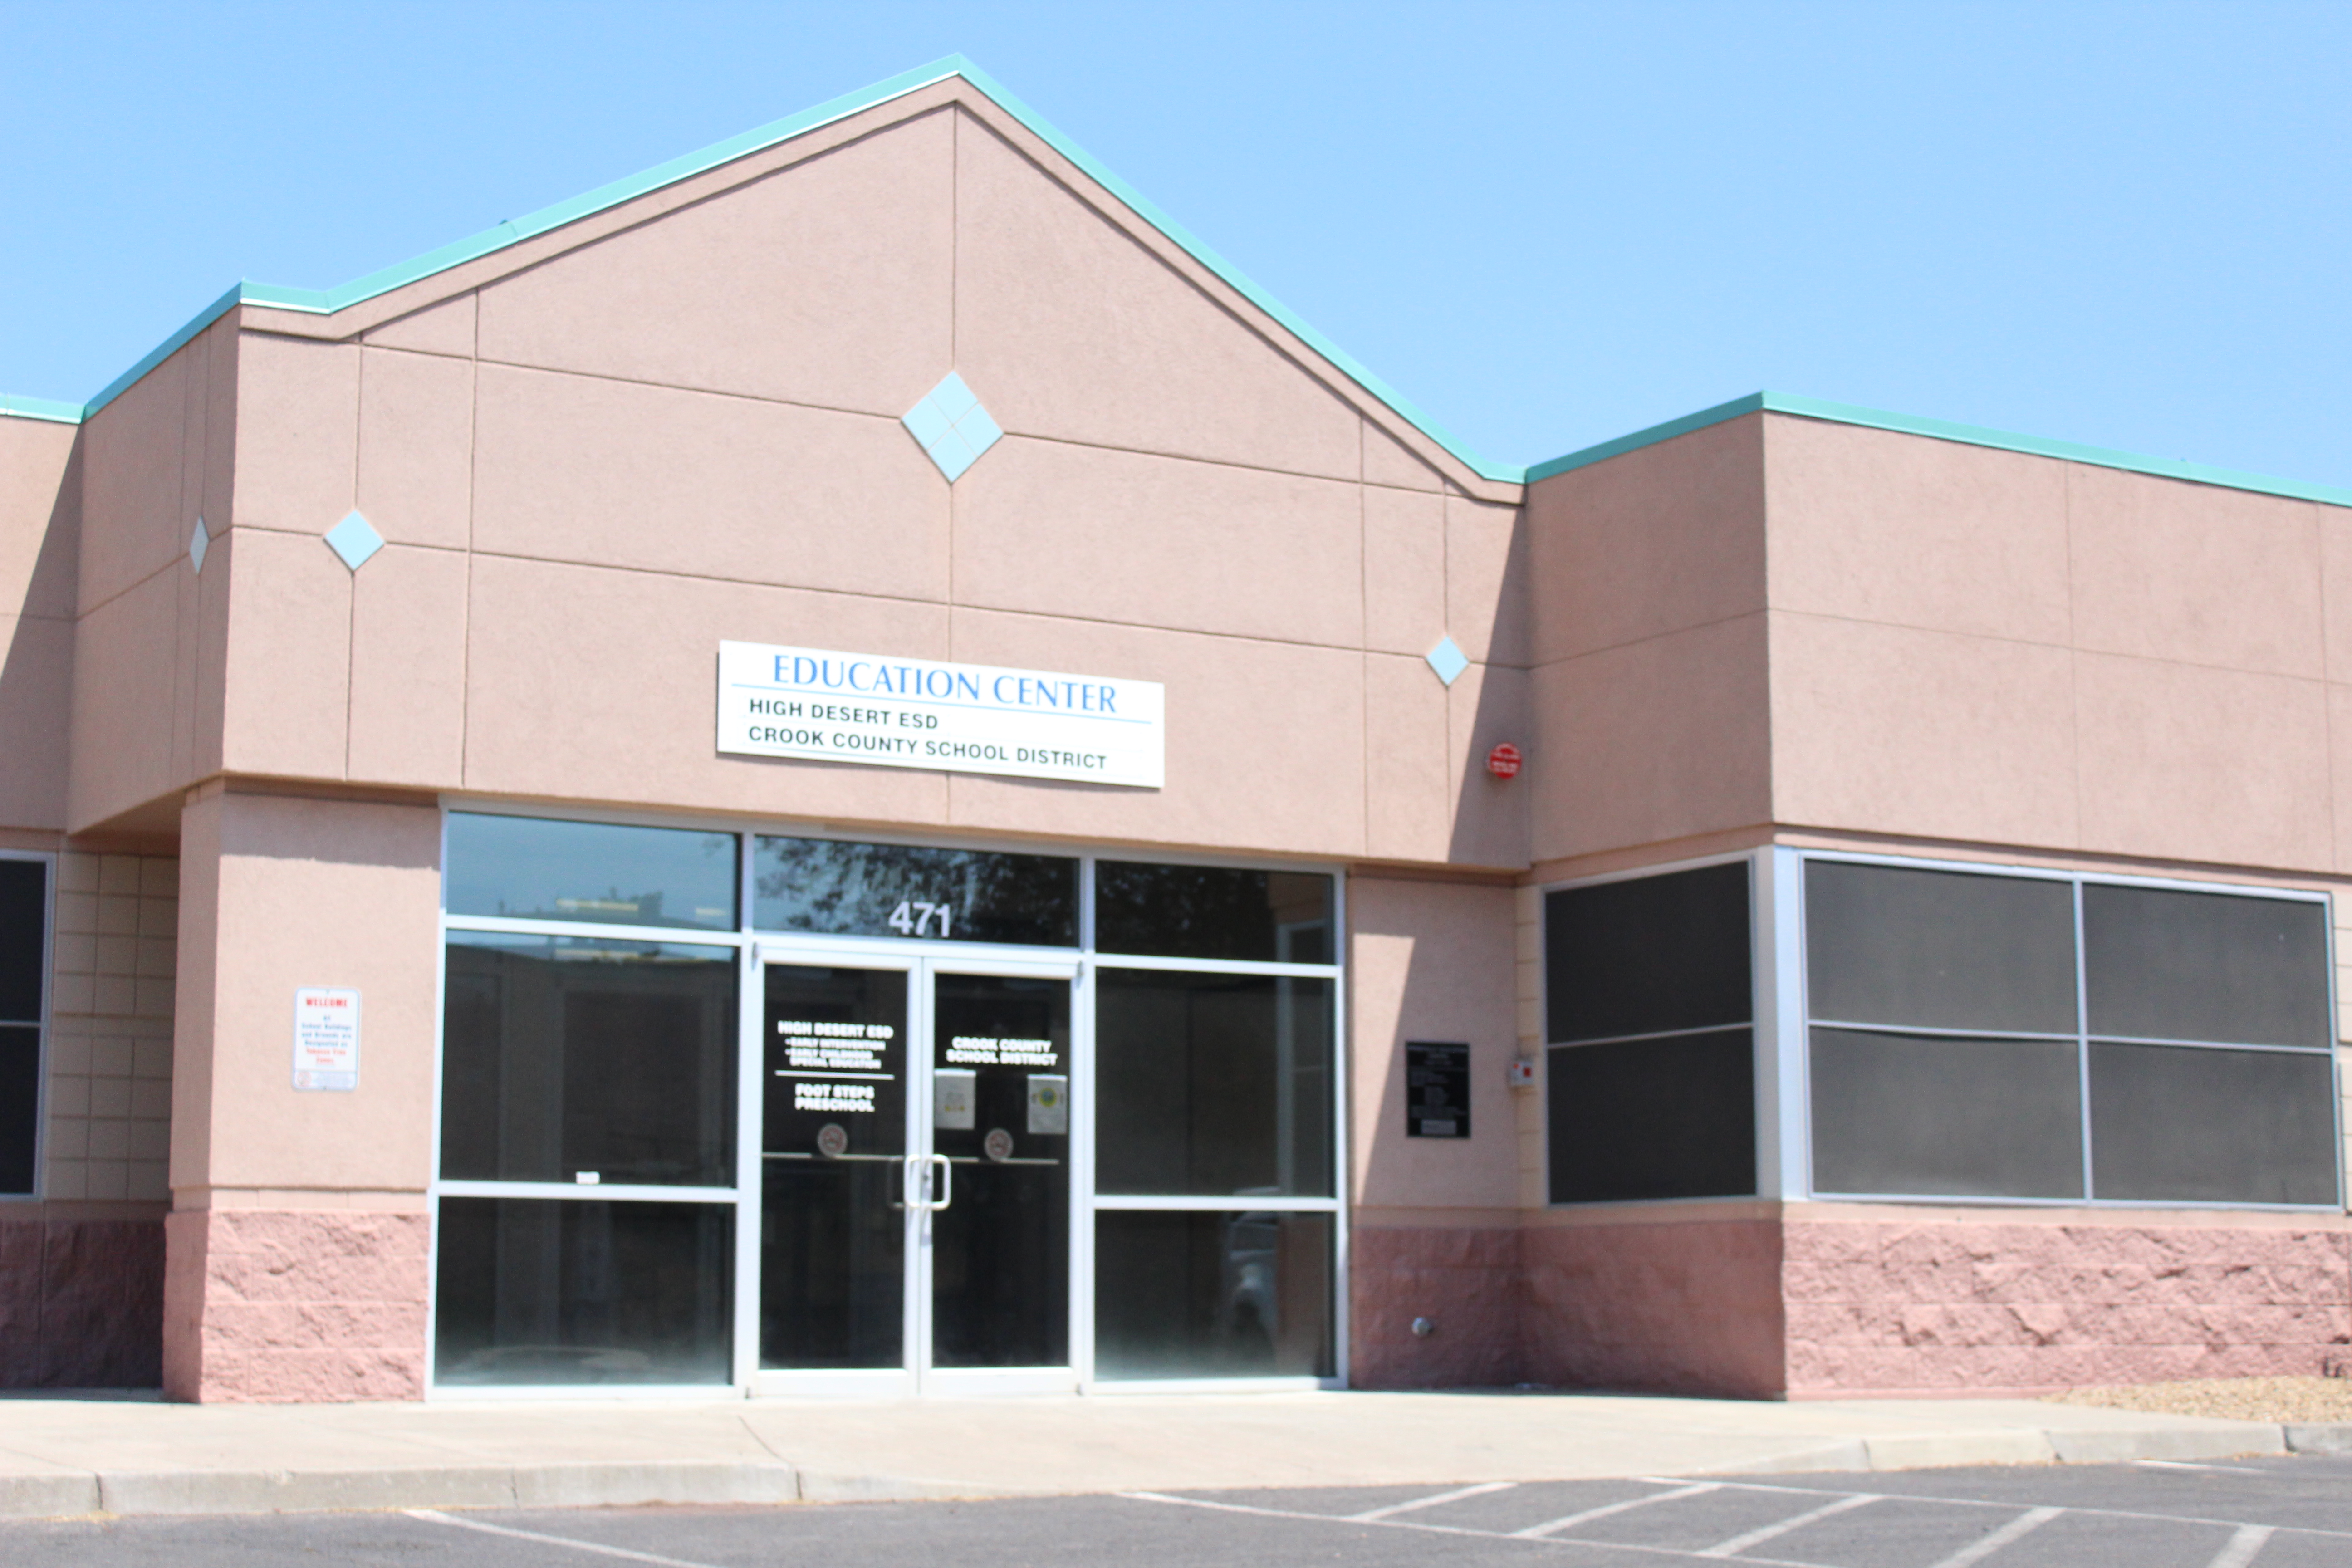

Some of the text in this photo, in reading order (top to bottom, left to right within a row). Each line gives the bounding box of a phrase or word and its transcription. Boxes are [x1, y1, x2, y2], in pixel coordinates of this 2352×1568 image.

[774, 654, 1116, 713] EDUCATION CENTER
[750, 698, 938, 730] HIGH DESERT ESD
[749, 726, 1107, 769] CROOK COUNTY SCHOOL DISTRICT
[889, 901, 950, 937] 471
[306, 998, 347, 1006] WELCOME
[778, 1021, 894, 1039] HIGH DESERT ESD
[819, 1039, 886, 1051] INTERVENTION
[952, 1036, 1052, 1053] CROOK COUNTY
[829, 1058, 882, 1069] EDUCATION
[946, 1049, 1058, 1066] SCHOOL DISTRICT
[795, 1083, 875, 1099] FOOT STEPS
[795, 1097, 875, 1112] PRESCHOOL
